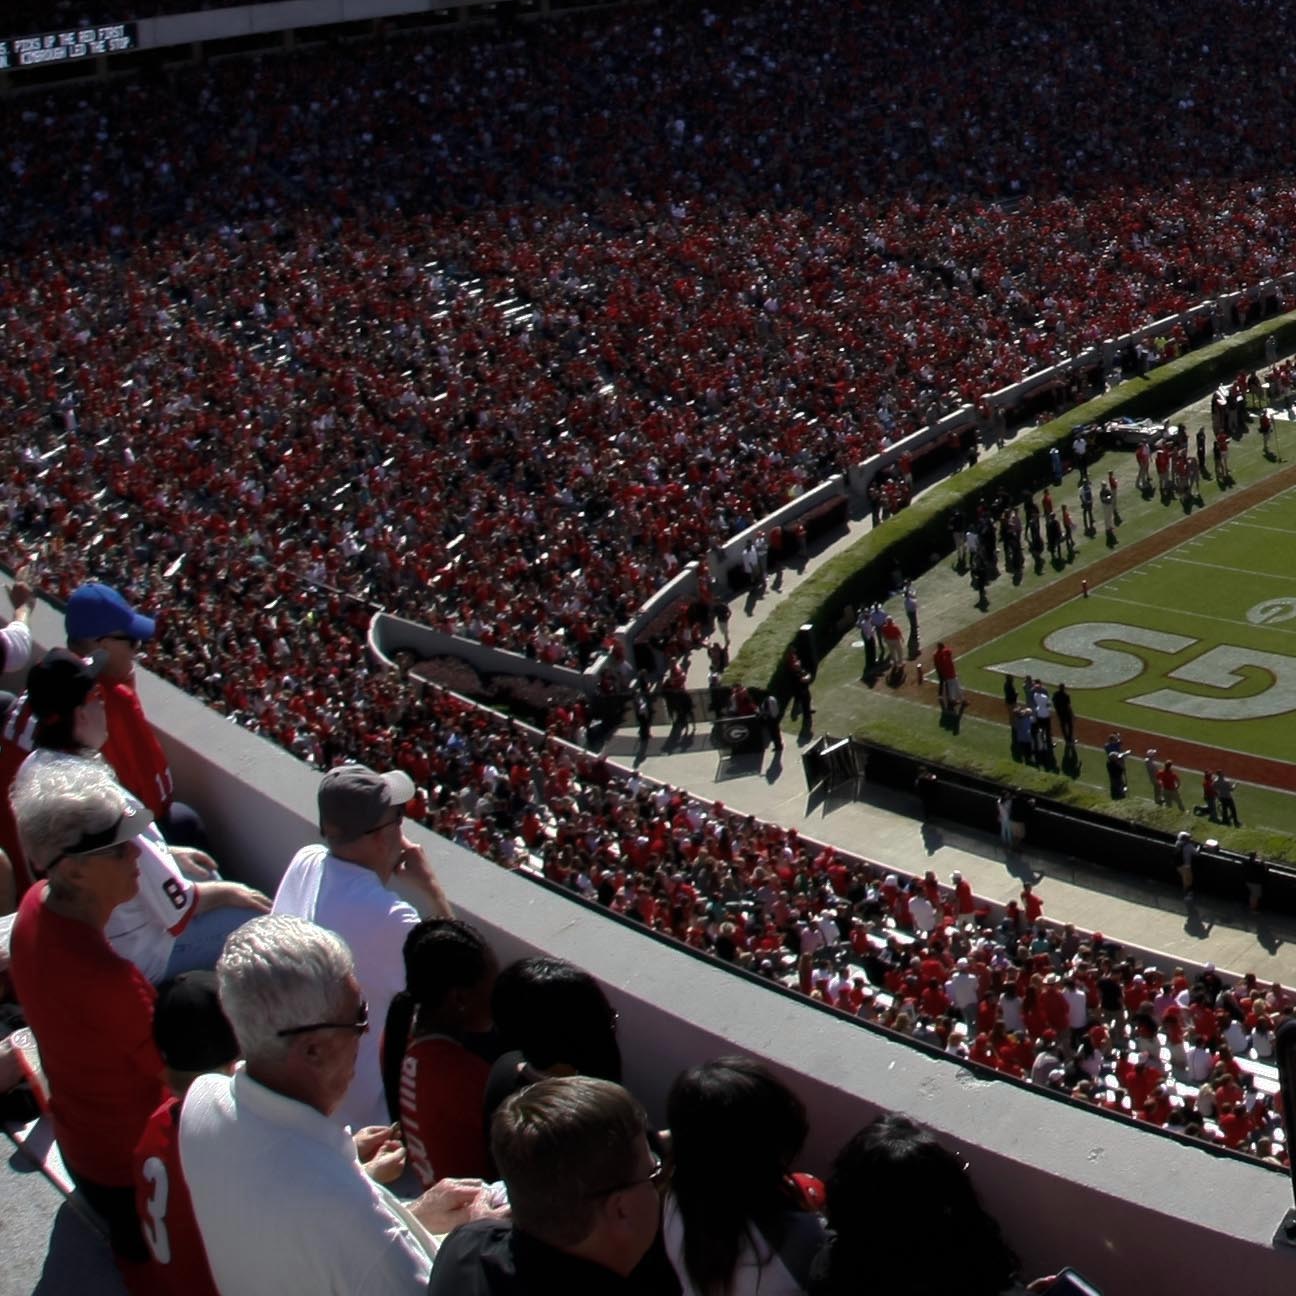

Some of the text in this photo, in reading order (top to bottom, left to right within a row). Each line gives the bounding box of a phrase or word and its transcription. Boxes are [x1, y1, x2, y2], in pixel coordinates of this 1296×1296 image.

[13, 37, 42, 54] PICKS
[43, 35, 56, 49] UP
[57, 32, 76, 46] THE
[78, 29, 96, 43] RED
[97, 24, 125, 40] FIRST
[68, 43, 87, 58] LED
[89, 39, 107, 54] THE
[162, 877, 188, 910] 8
